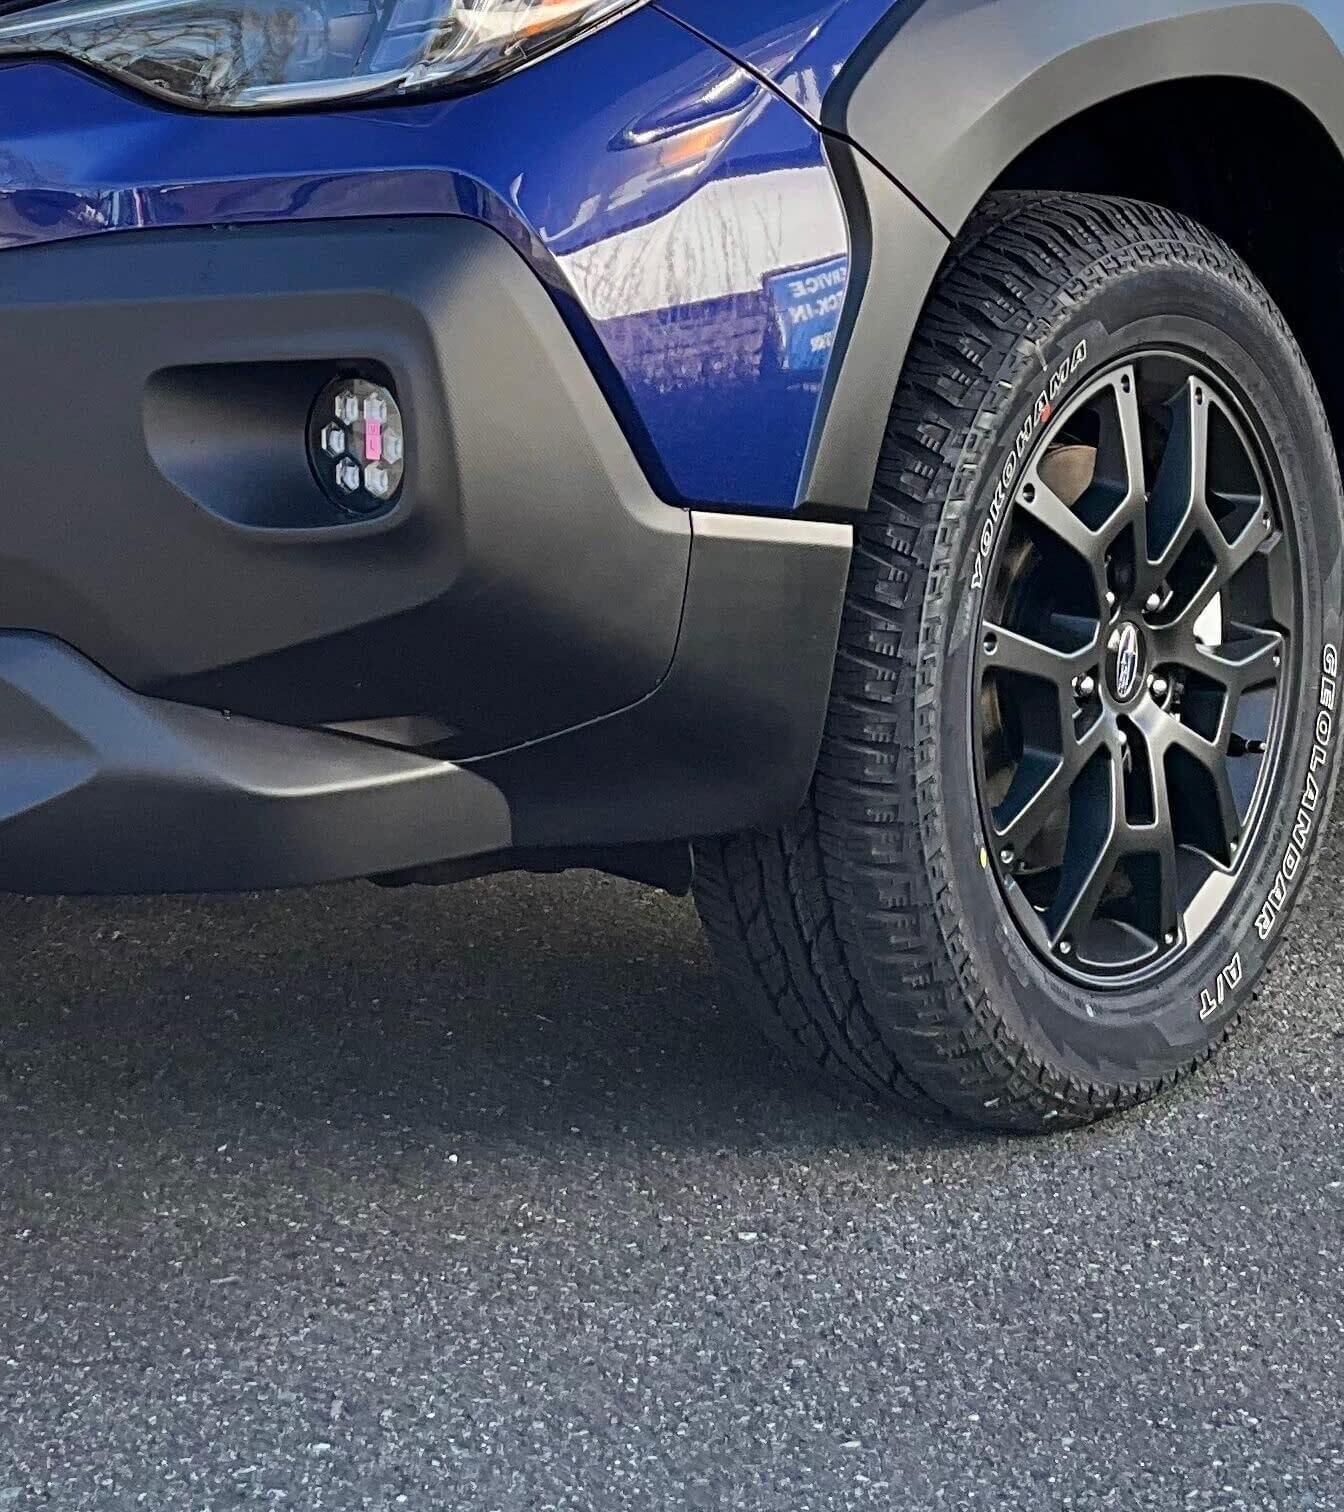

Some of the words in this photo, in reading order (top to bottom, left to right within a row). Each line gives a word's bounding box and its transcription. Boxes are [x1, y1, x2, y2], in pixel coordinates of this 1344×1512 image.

[971, 339, 1087, 589] YOKOHAMA
[1254, 643, 1337, 941] GEOLANDAR
[1199, 952, 1243, 1020] A/T
